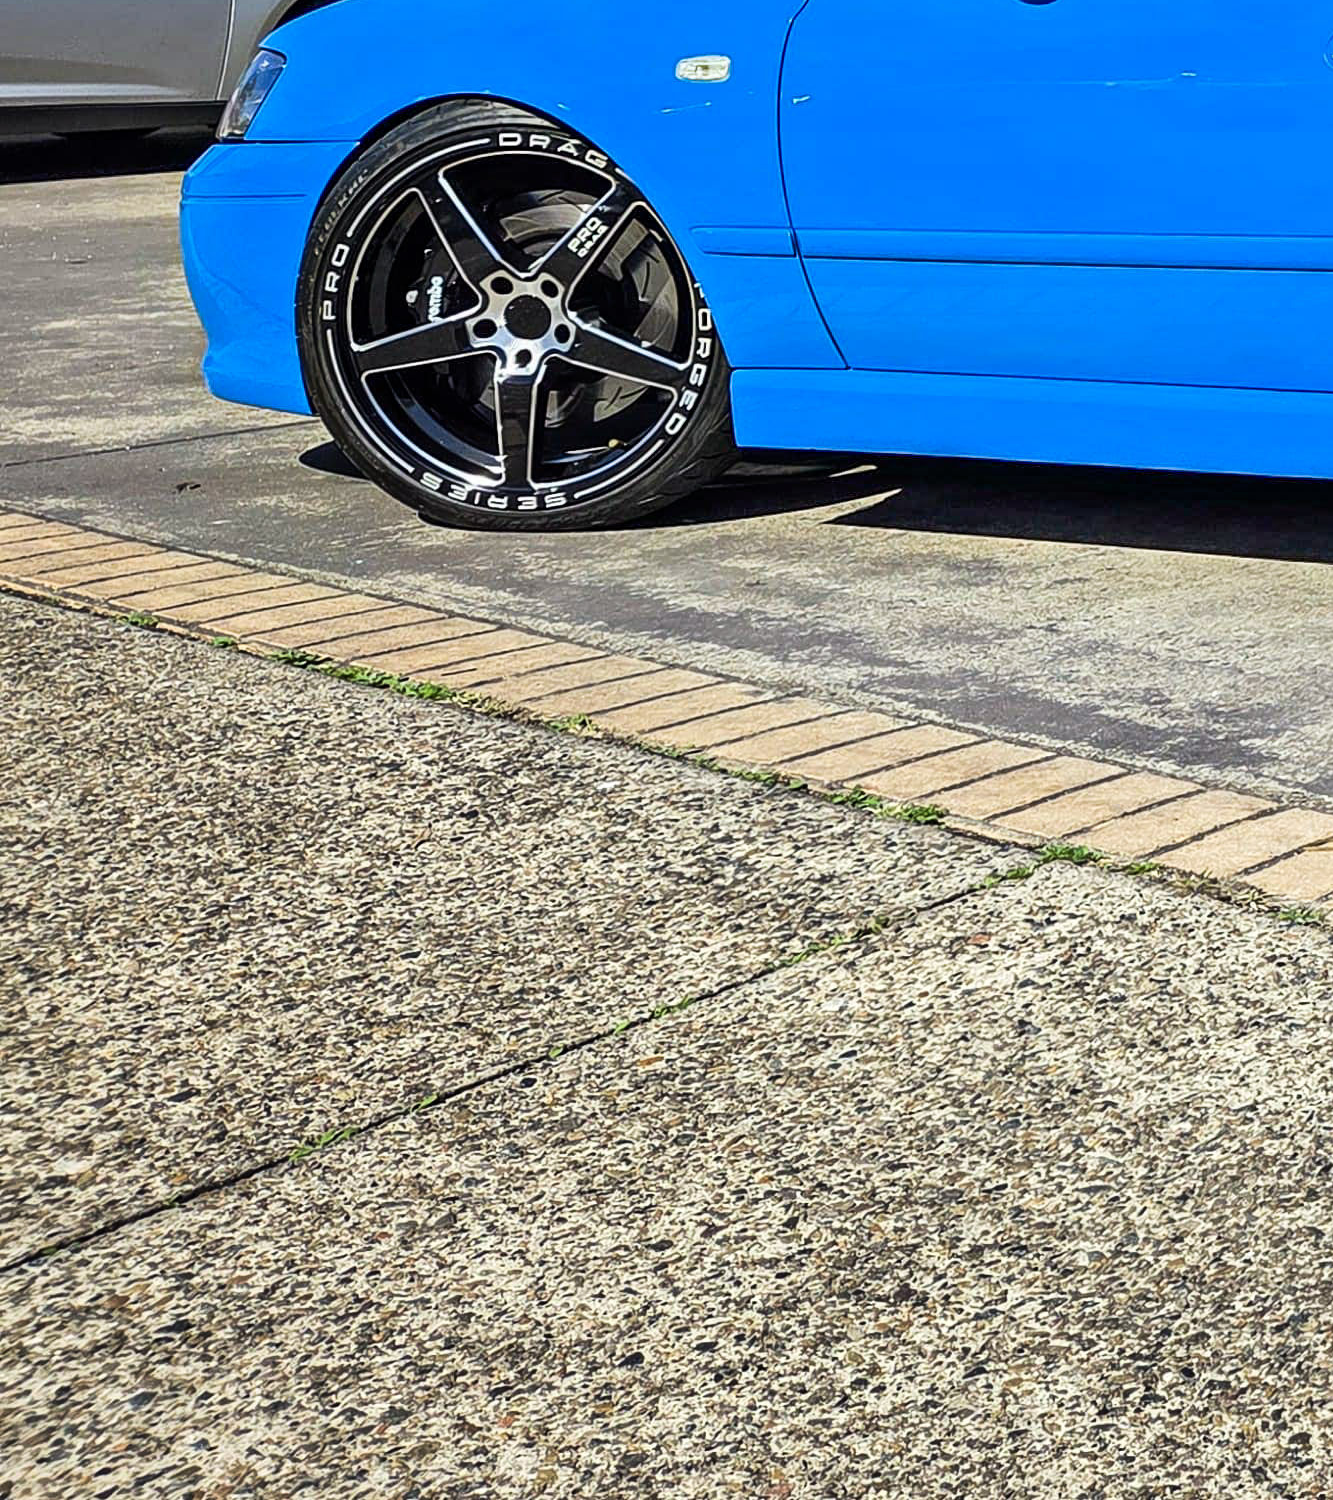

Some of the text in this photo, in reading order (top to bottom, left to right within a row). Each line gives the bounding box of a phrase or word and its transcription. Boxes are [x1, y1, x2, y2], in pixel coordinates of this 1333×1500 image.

[498, 132, 608, 170] DRAG
[568, 217, 602, 253] PRO
[321, 243, 351, 322] PRO
[418, 472, 568, 511] SERIES
